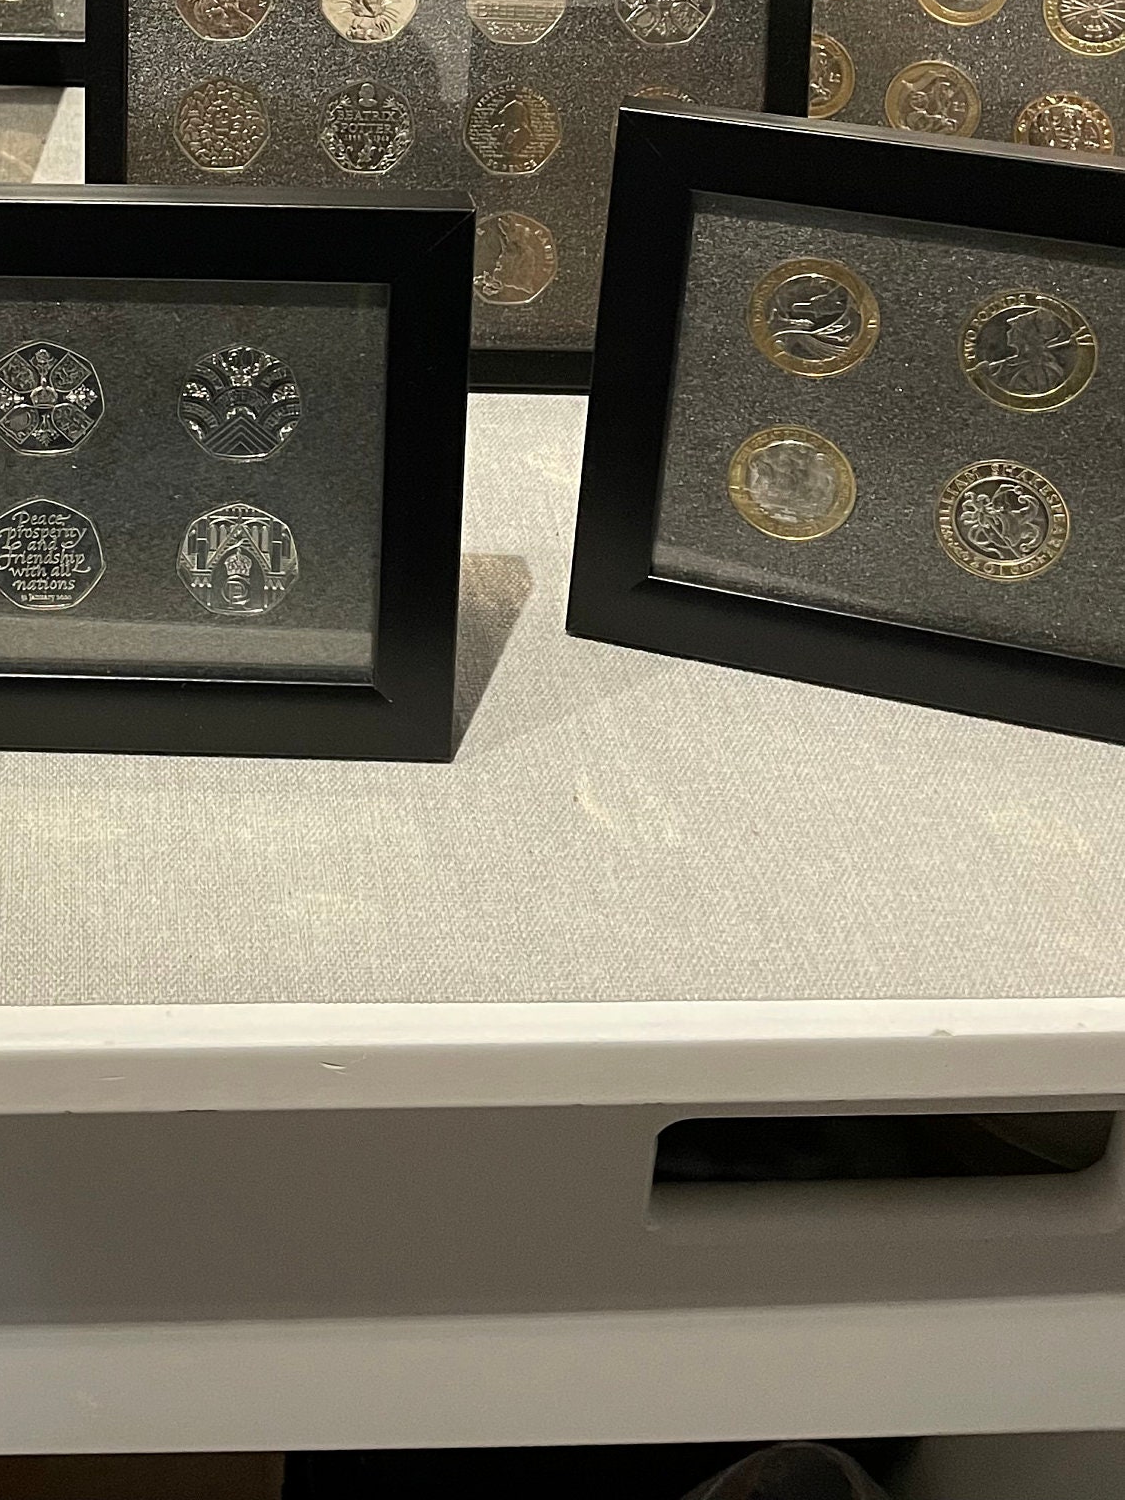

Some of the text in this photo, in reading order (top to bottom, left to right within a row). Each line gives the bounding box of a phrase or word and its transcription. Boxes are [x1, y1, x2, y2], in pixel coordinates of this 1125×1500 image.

[334, 109, 397, 121] BEATRIX
[339, 121, 394, 135] POTTER
[963, 329, 977, 361] TWO
[26, 536, 59, 551] and
[8, 562, 73, 577] with all
[11, 577, 76, 591] nations
